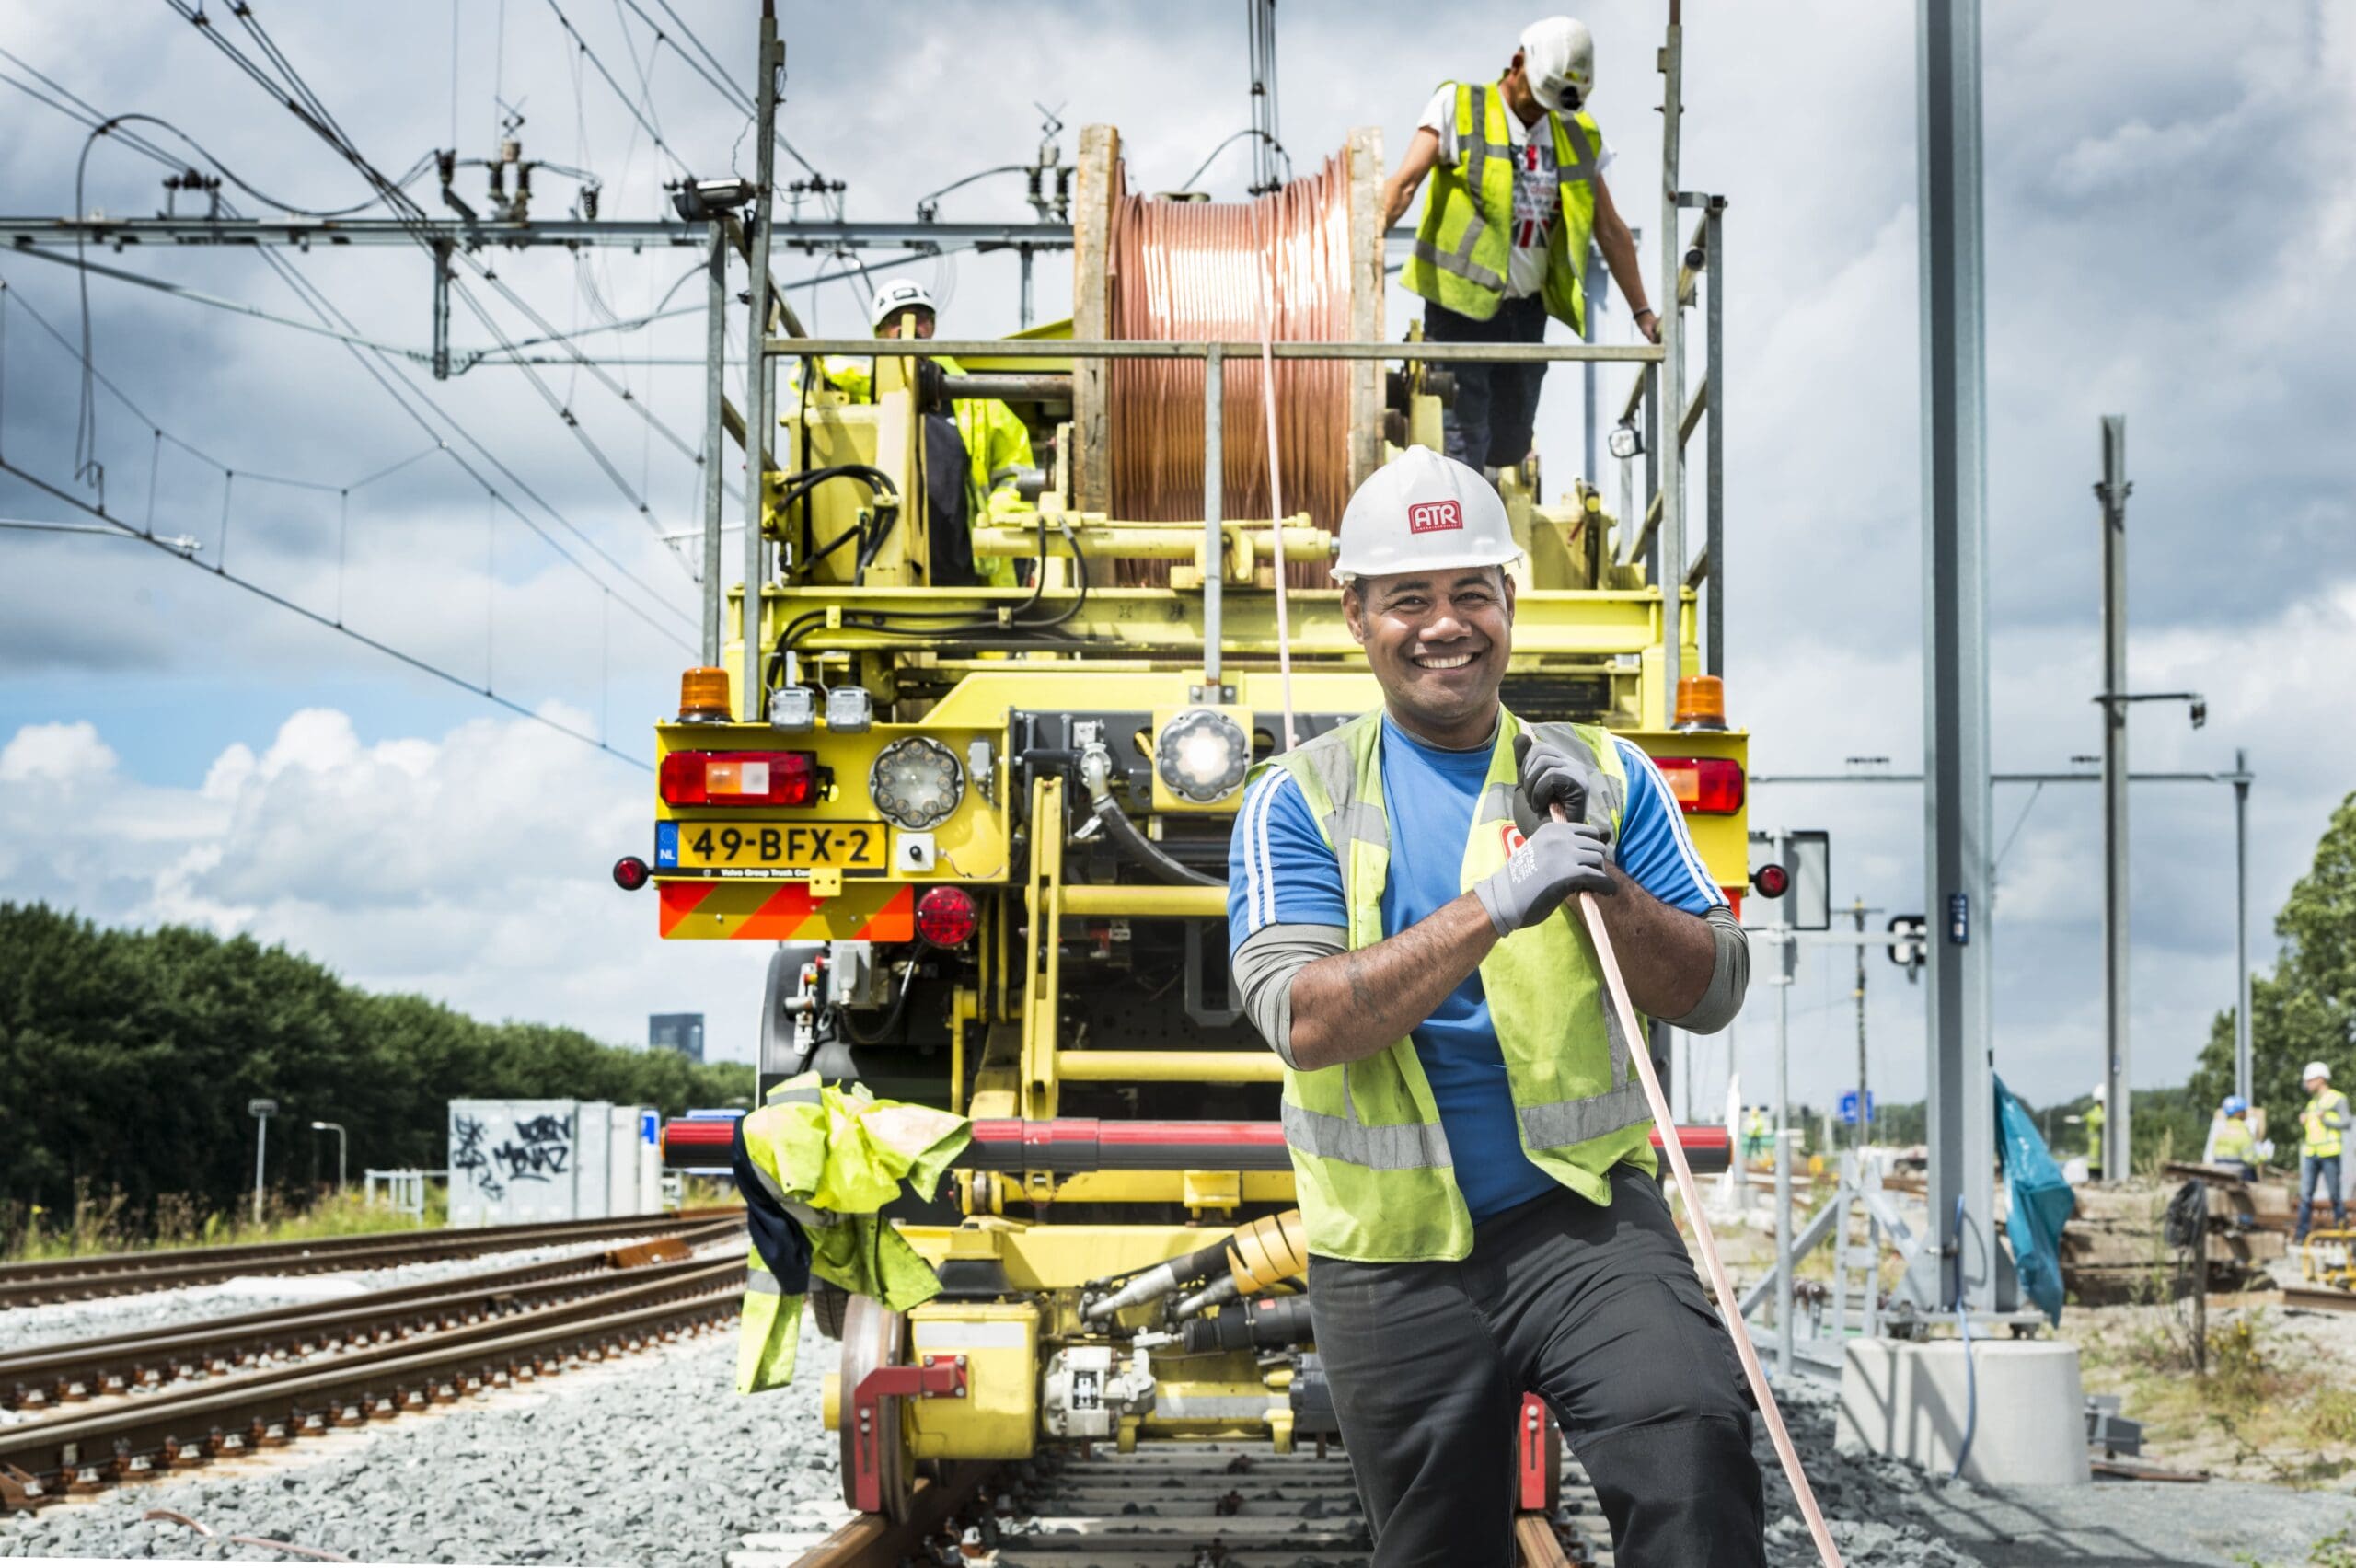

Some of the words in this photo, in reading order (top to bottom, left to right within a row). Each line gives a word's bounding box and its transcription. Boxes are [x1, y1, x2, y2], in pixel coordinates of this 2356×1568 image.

[1414, 504, 1458, 527] ATR
[660, 849, 676, 860] NL
[692, 828, 870, 862] 49-BFX-2
